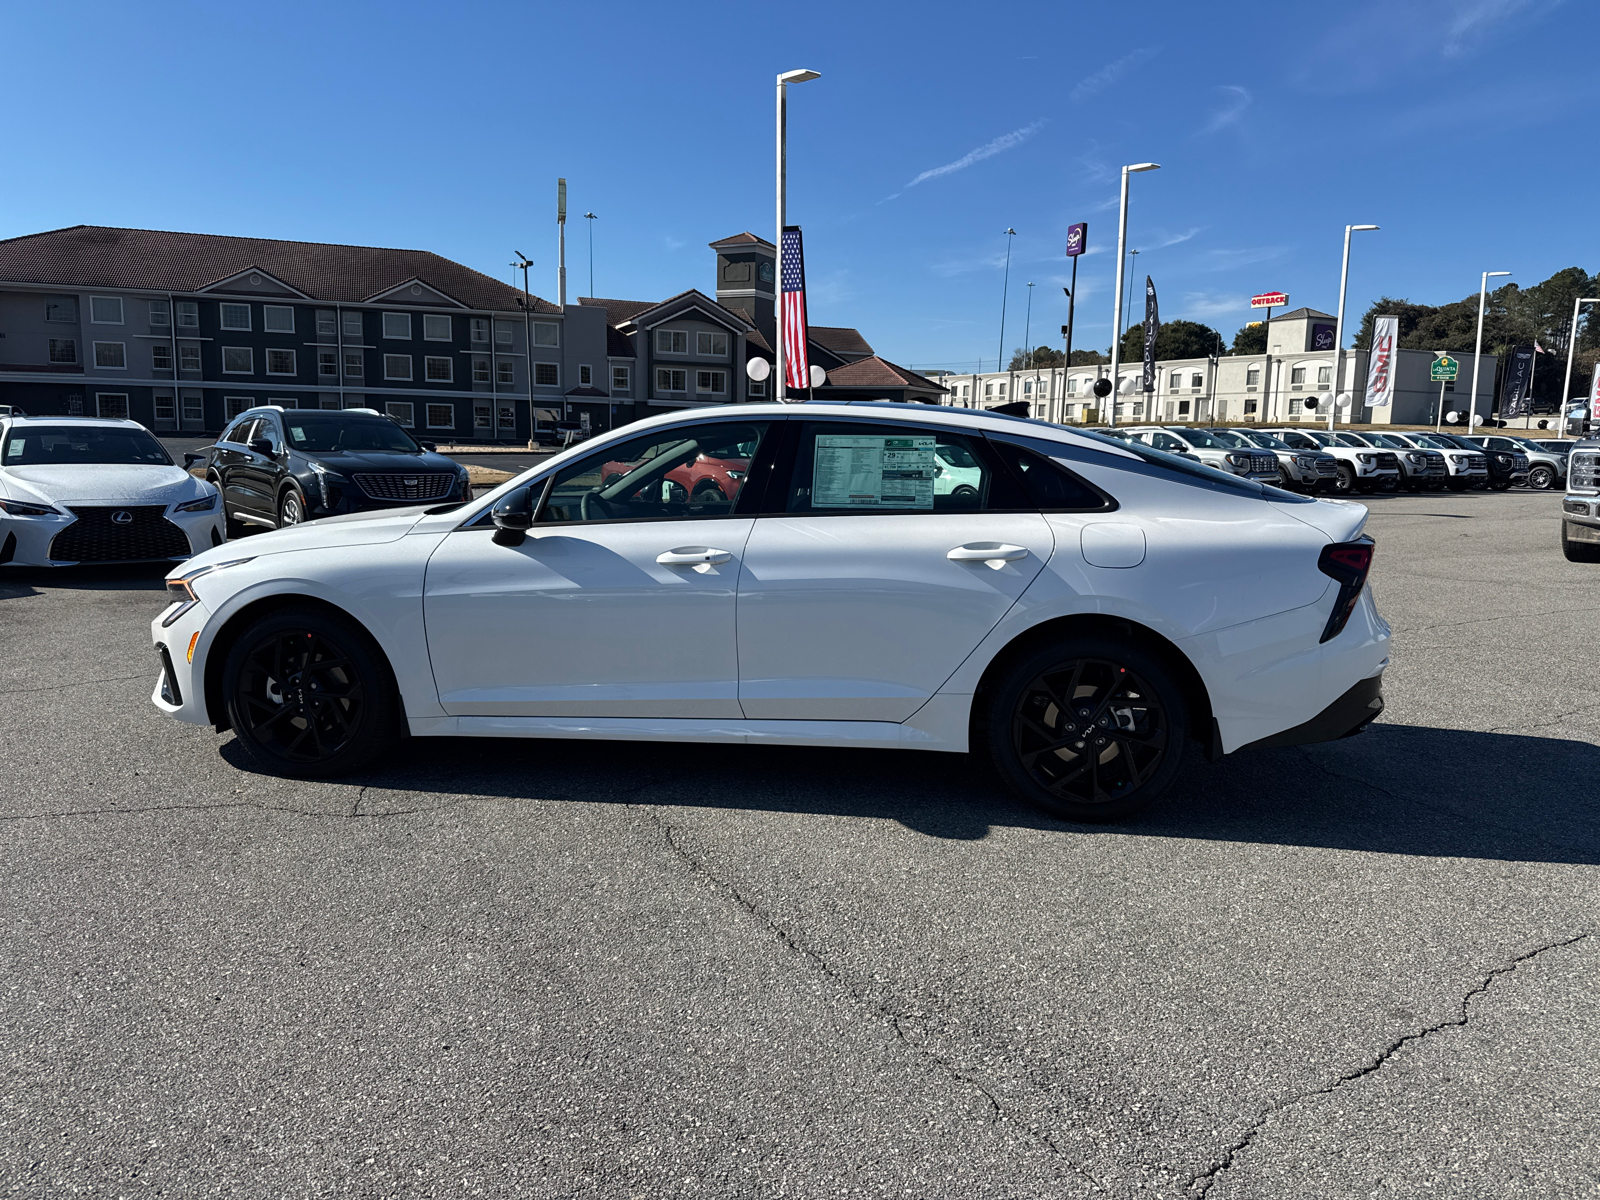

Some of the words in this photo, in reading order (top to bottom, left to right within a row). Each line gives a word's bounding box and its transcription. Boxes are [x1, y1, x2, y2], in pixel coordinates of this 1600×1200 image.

[1251, 296, 1285, 305] OUTBACK
[1144, 301, 1154, 385] CADILLAC
[1373, 335, 1392, 393] GMC
[1509, 362, 1525, 415] CADILLAC
